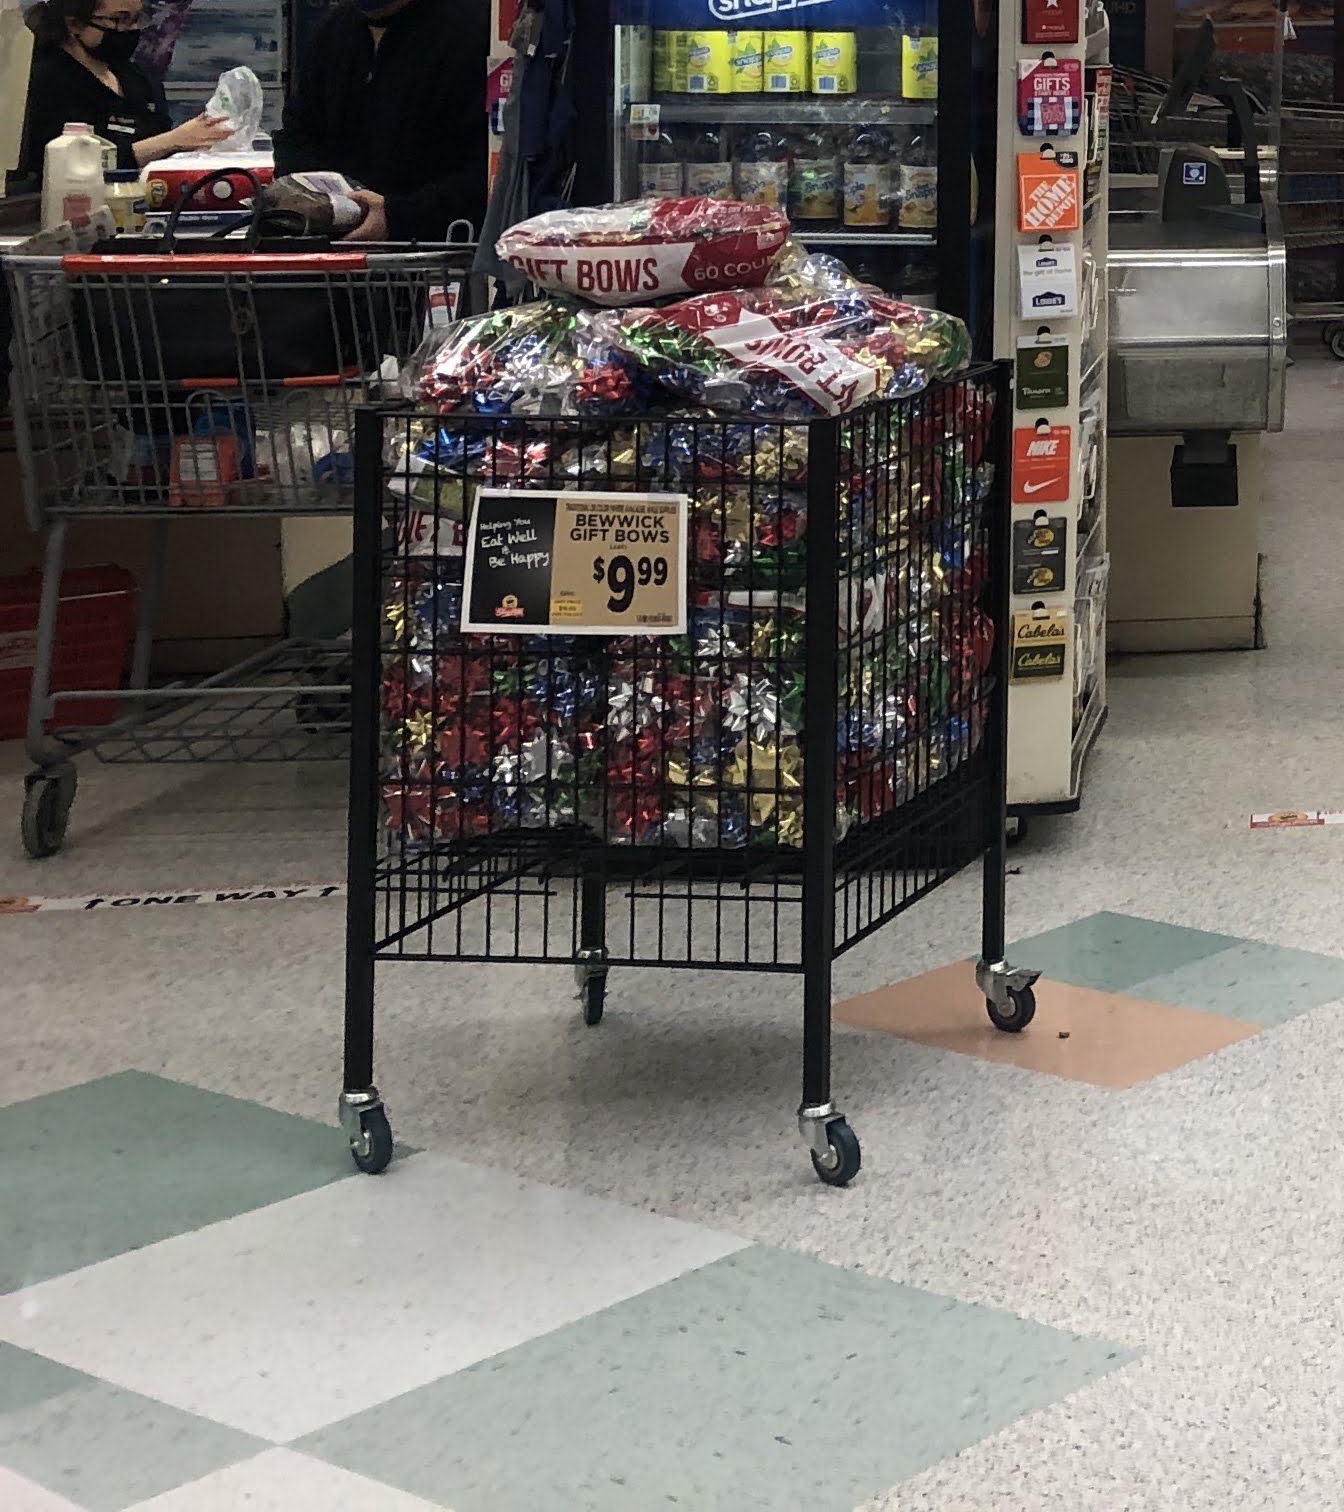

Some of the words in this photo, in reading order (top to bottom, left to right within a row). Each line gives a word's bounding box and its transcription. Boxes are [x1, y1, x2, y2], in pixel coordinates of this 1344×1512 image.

[1033, 77, 1071, 90] GIFTS
[1024, 173, 1076, 228] HOME
[1028, 180, 1050, 202] THE
[508, 254, 569, 284] GIFT
[576, 257, 660, 294] BOWS
[693, 264, 718, 283] 60
[1027, 439, 1059, 457] NIKE
[480, 521, 512, 532] Helping
[514, 518, 531, 526] You
[575, 513, 665, 529] BEWWICK
[481, 536, 504, 549] Eat
[507, 529, 538, 544] Well
[570, 528, 610, 543] GIFT
[615, 529, 670, 544] BOWS
[488, 556, 506, 569] Be
[510, 551, 550, 570] Happy
[109, 893, 202, 908] ONE
[214, 888, 309, 902] WAY
